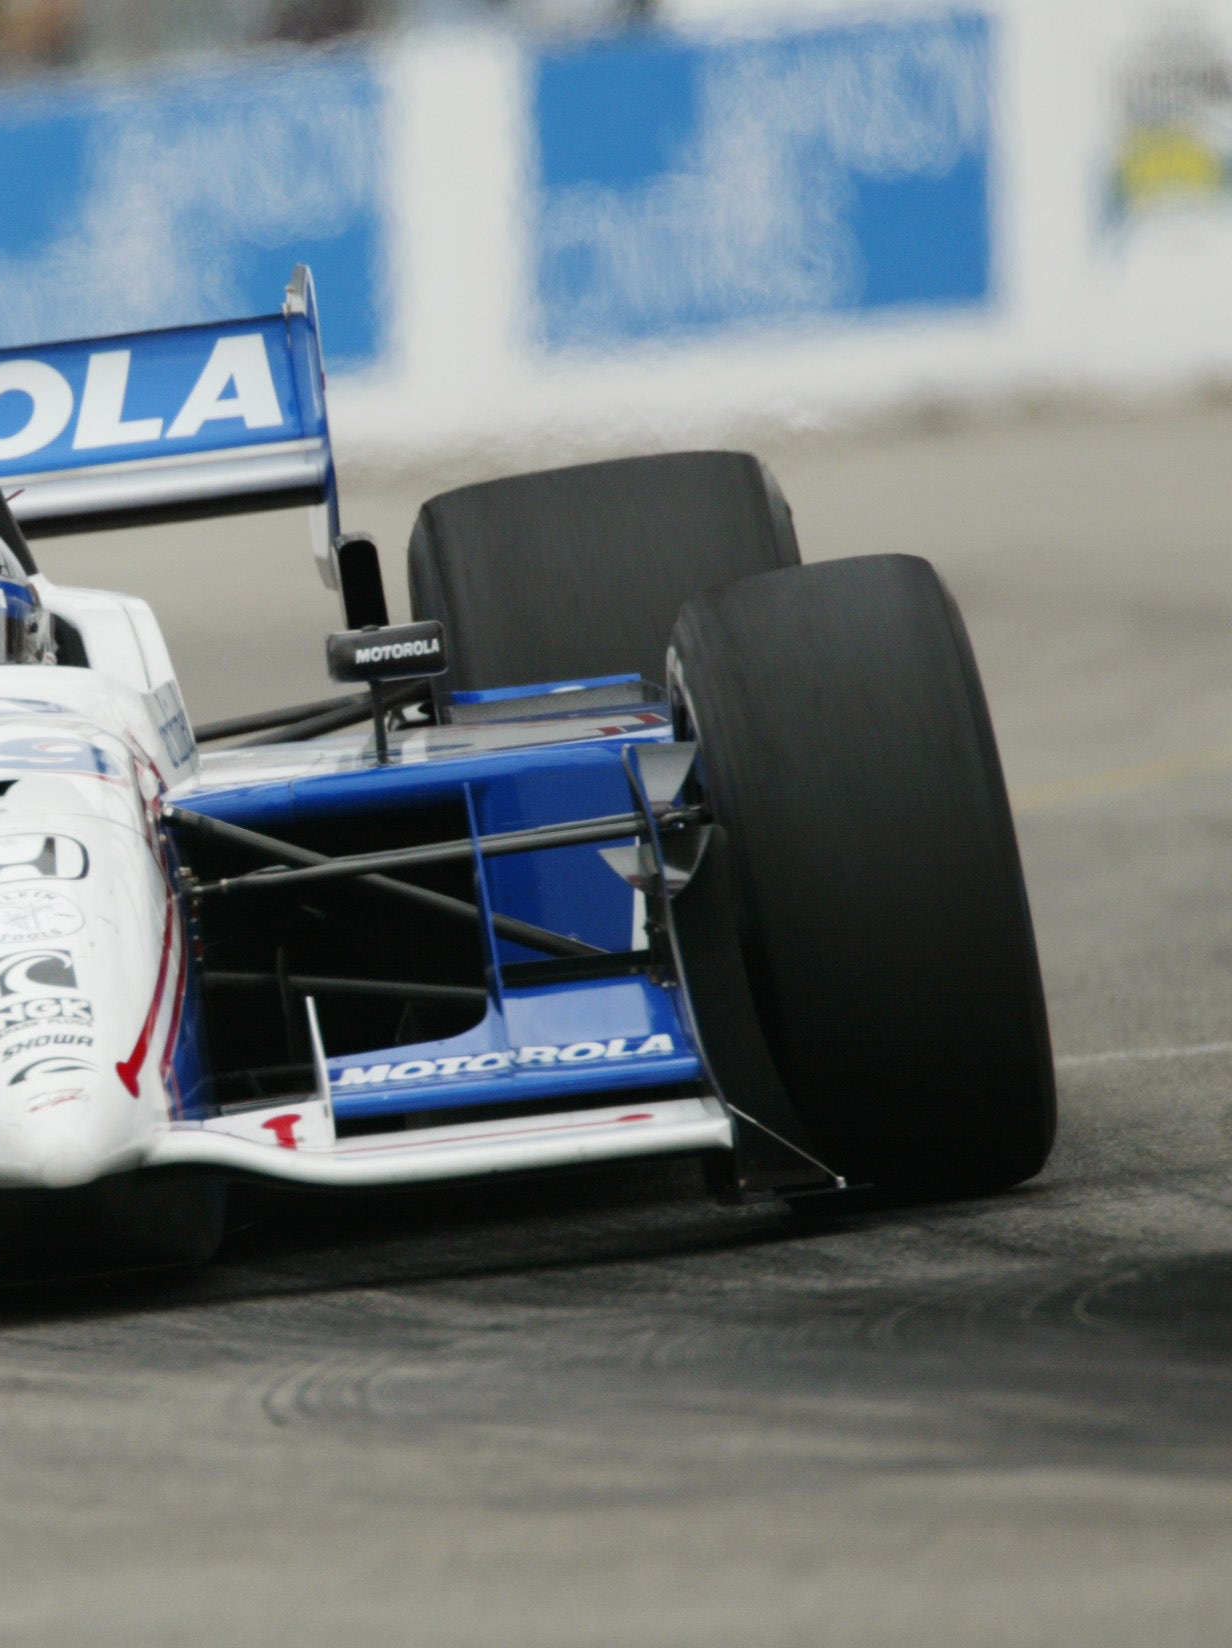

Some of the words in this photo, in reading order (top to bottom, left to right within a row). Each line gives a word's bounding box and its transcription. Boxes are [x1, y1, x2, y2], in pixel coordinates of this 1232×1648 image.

[355, 638, 440, 664] MOTOROLA
[1, 1033, 95, 1064] SHOWA
[340, 1034, 674, 1086] MOTOROLA
